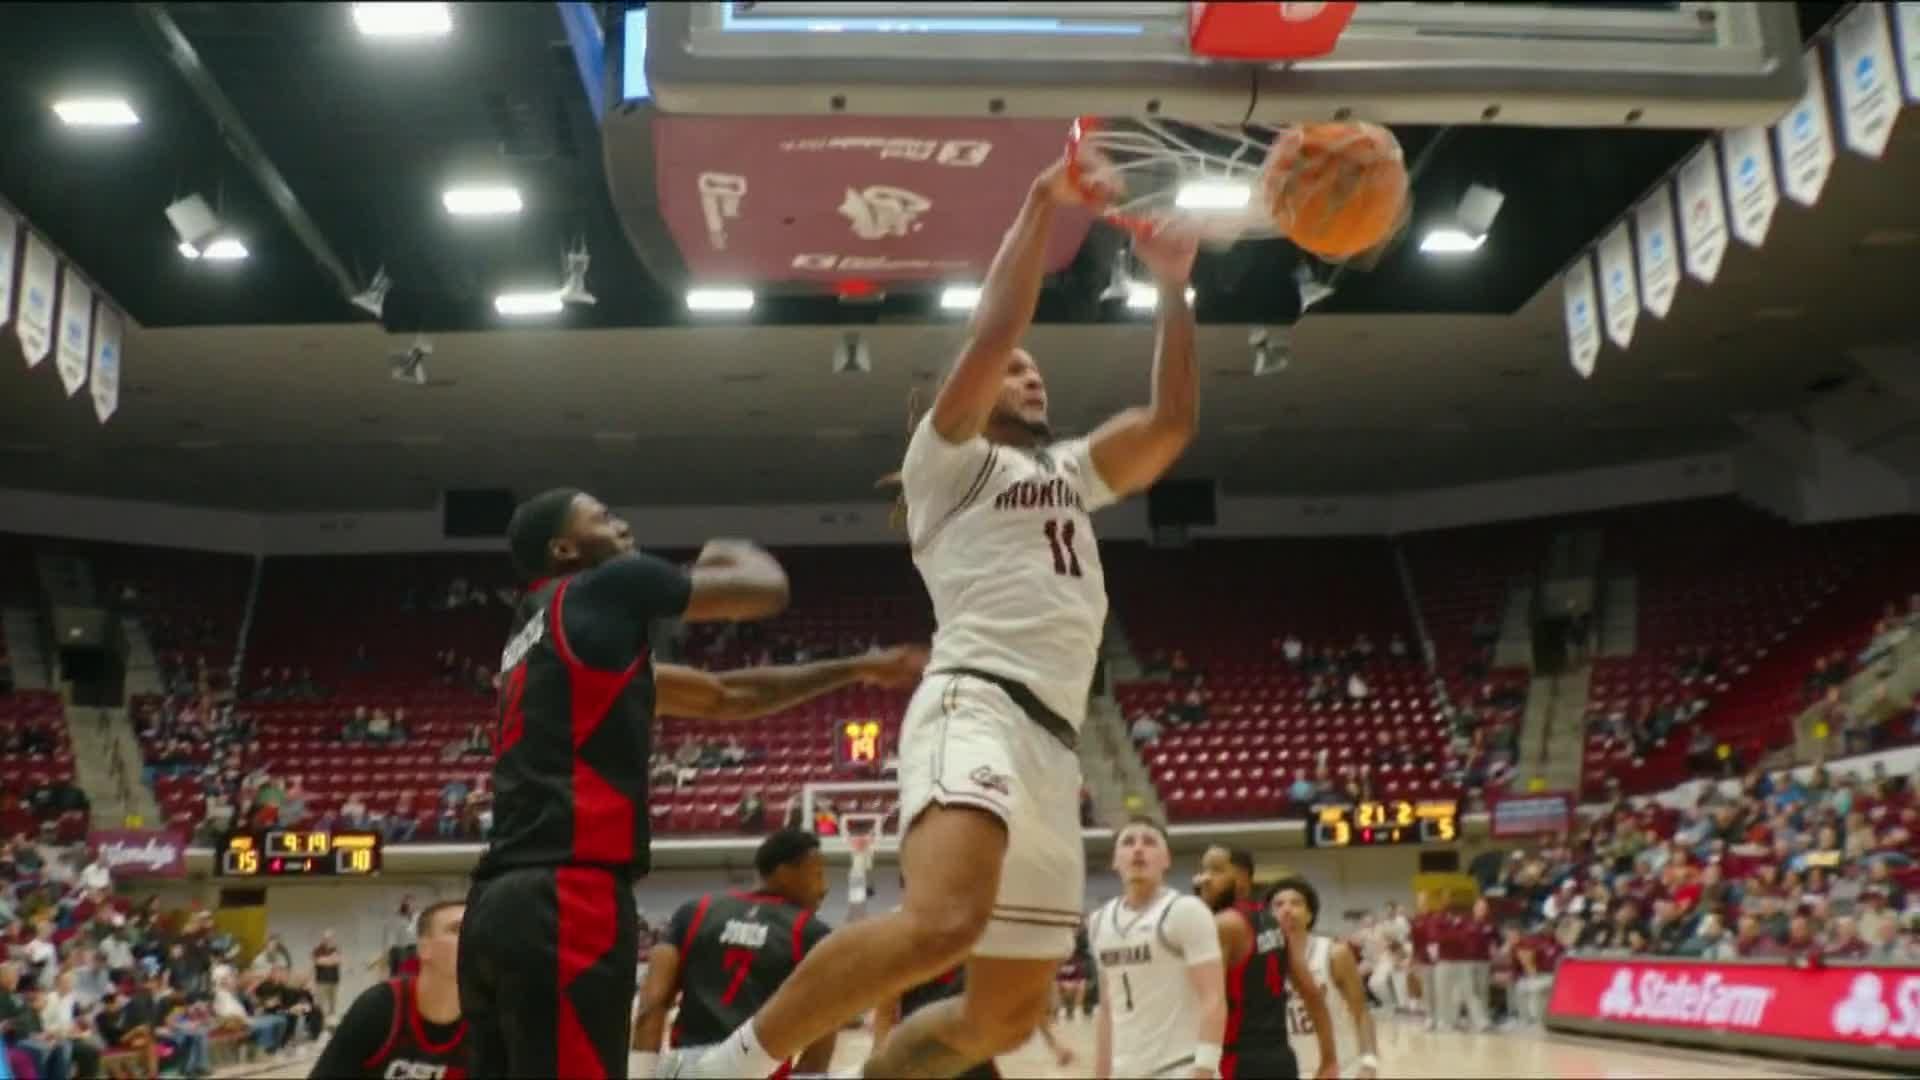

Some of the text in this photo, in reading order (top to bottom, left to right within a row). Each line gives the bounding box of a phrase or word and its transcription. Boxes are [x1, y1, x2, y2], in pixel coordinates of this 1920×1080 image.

[1044, 519, 1083, 577] 11
[239, 849, 257, 873] 15
[721, 947, 752, 1005] 7
[1122, 971, 1134, 1012] 1
[1264, 950, 1284, 998] 4
